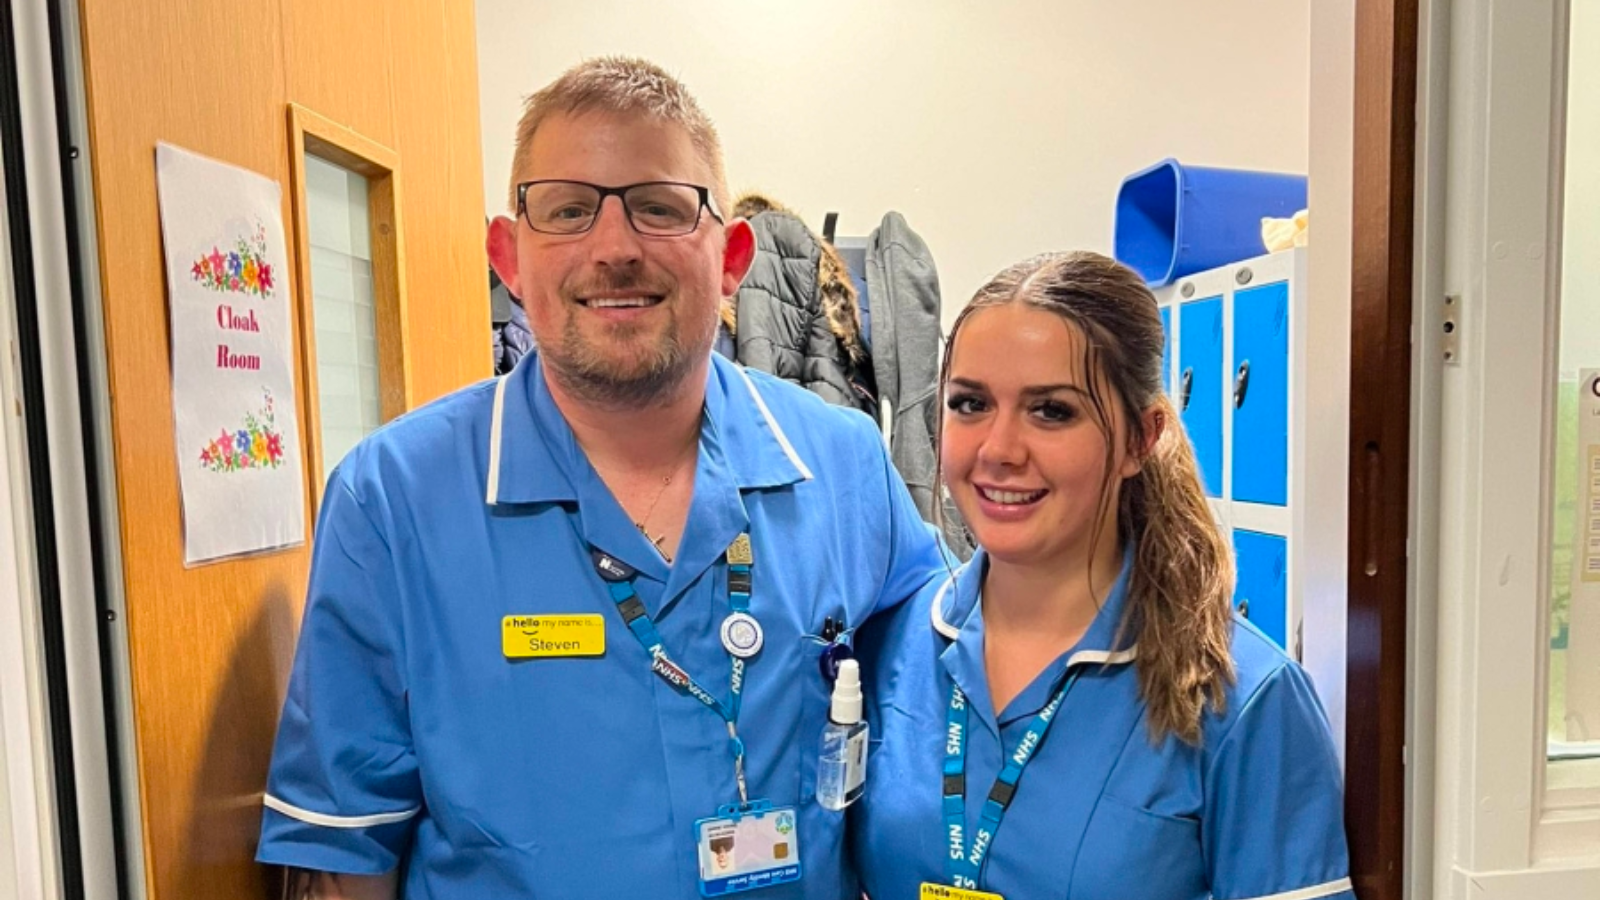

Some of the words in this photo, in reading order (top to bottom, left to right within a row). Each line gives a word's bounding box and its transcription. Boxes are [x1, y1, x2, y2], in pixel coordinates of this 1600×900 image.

[217, 304, 260, 333] Cloak
[217, 344, 260, 371] Room
[542, 619, 557, 629] my
[558, 617, 583, 627] name
[529, 638, 581, 651] Steven
[732, 658, 745, 694] NHS
[951, 683, 965, 711] HS
[946, 721, 963, 756] NHS
[1012, 730, 1039, 766] NHS
[948, 824, 965, 862] NHS
[968, 828, 992, 867] NHS
